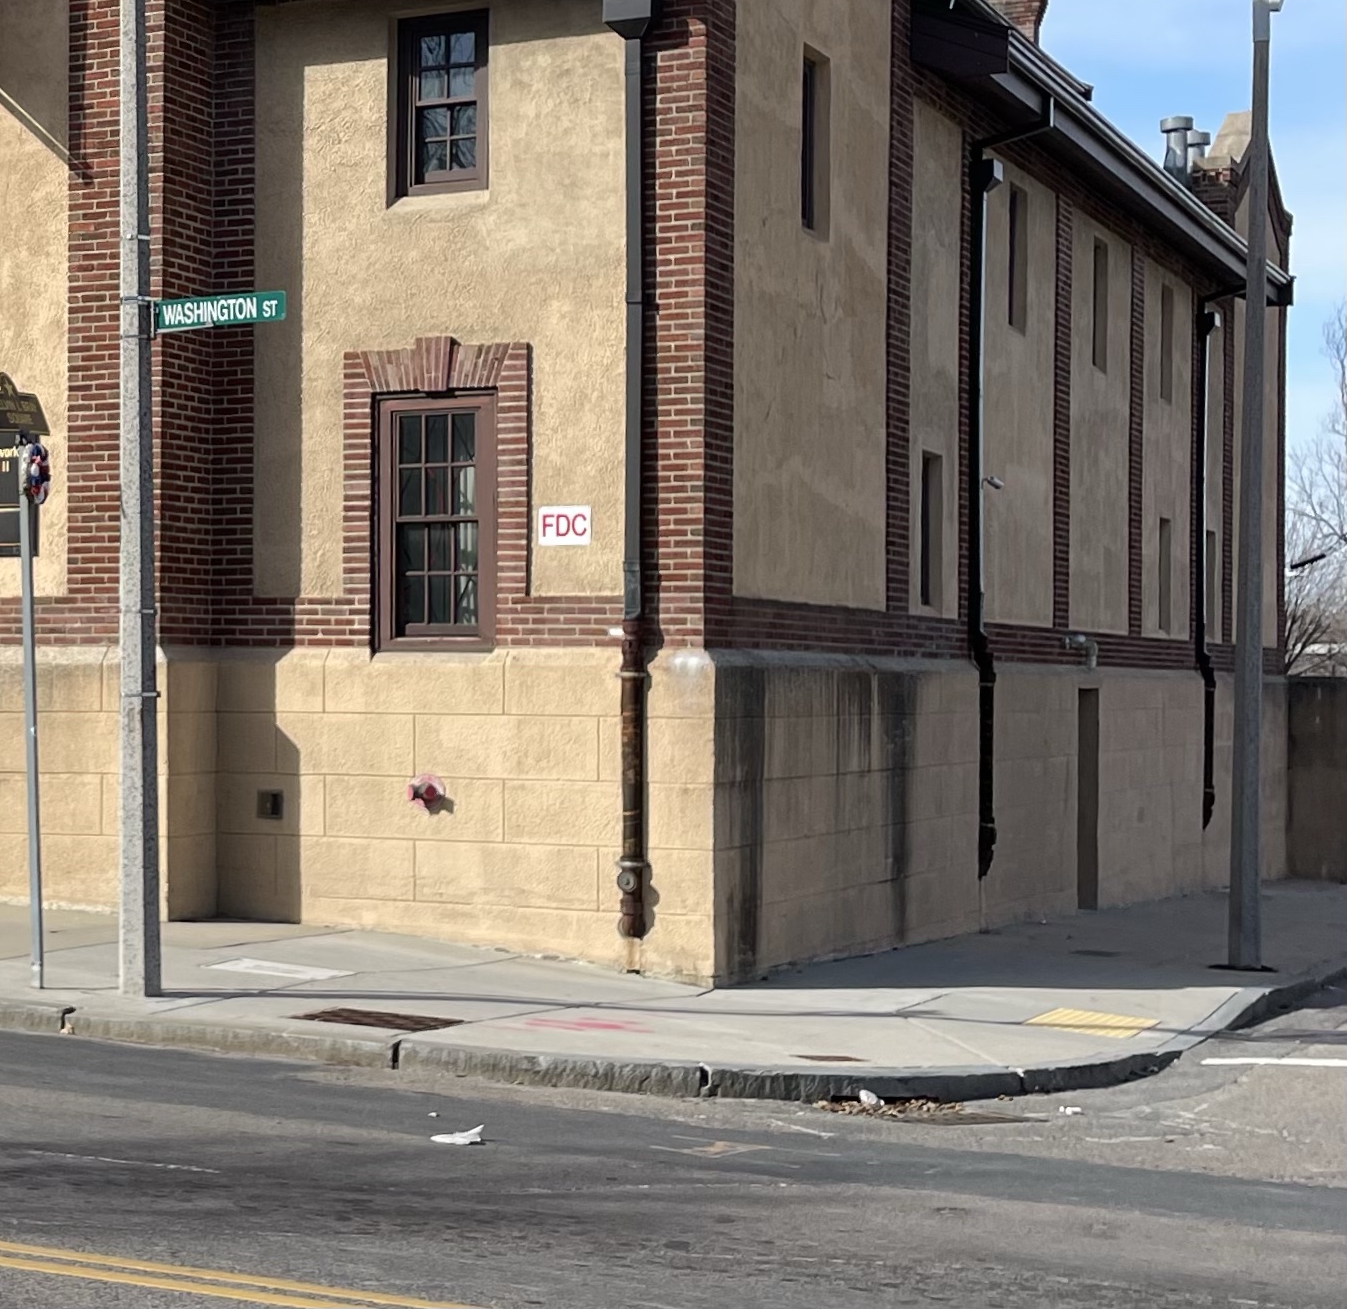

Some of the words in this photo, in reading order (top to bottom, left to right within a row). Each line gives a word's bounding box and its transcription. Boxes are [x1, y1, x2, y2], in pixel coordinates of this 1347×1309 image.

[162, 297, 257, 326] WASHINGTON
[262, 300, 278, 318] ST
[542, 513, 587, 537] FDC
